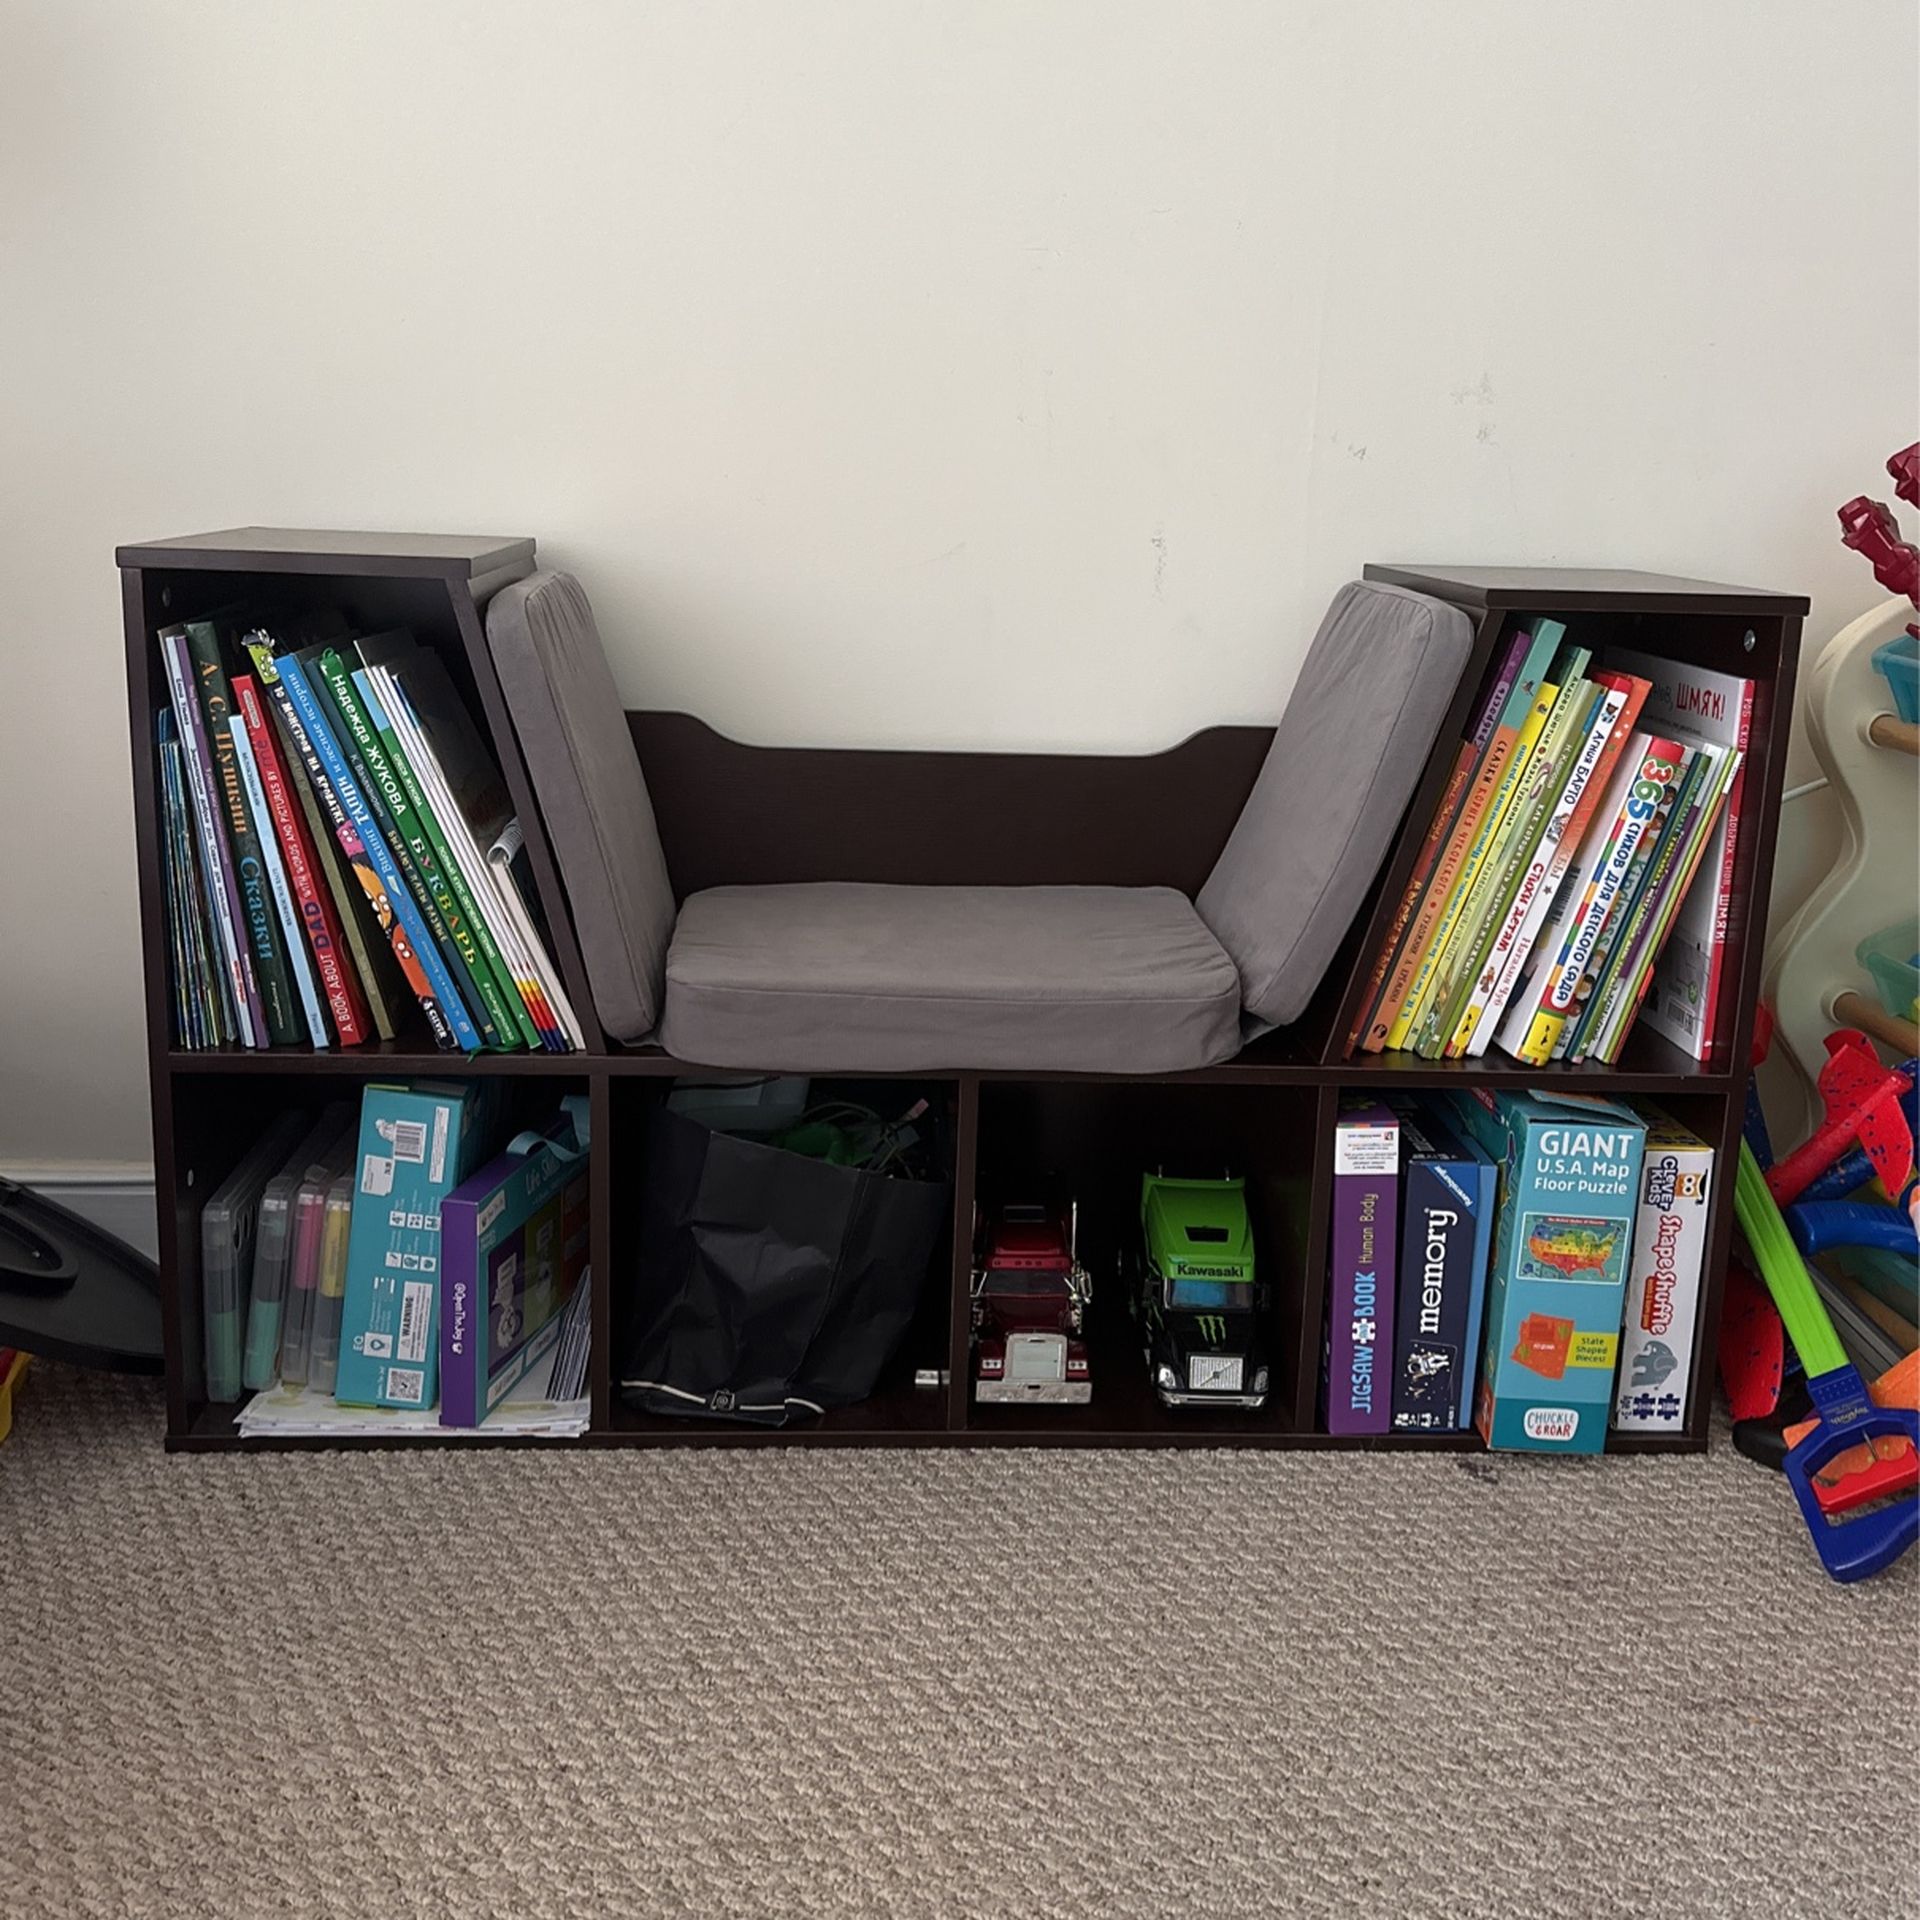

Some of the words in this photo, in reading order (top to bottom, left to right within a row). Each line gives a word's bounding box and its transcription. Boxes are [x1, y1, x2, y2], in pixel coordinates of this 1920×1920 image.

[201, 661, 216, 685] А.
[209, 696, 225, 721] С.
[288, 673, 315, 720] истории
[1673, 682, 1728, 718] ШМЯК!
[1742, 698, 1751, 716] РОБ
[313, 723, 336, 761] лесные
[332, 674, 369, 742] Надежда
[366, 745, 405, 814] ЖУКОВА
[1584, 730, 1604, 763] Агния
[281, 702, 310, 751] МОНСТРОВ
[307, 756, 319, 770] НА
[316, 775, 344, 822] КРОВАТКЕ
[1483, 740, 1506, 782] СКАЗКИ
[215, 733, 246, 831] Пушкин
[338, 776, 368, 824] ТАППИ
[1564, 765, 1589, 804] БАРТО
[1623, 759, 1676, 824] 365
[270, 782, 288, 822] PICTURES
[1463, 787, 1486, 826] КОРНЕЯ
[1532, 804, 1544, 821] КАК
[282, 824, 294, 840] AND
[364, 828, 391, 872] Викинг
[1613, 822, 1640, 867] СТИХОВ
[1726, 814, 1737, 854] ДОБРЫХ
[288, 843, 303, 873] WORDS
[1434, 832, 1467, 894] ЧУКОВСКОГО
[1504, 859, 1518, 881] БЫТЬ
[1720, 859, 1732, 888] СНОВ,
[297, 874, 311, 897] WITH
[388, 830, 412, 870] БЫВАЮТ
[410, 874, 427, 902] ПАПЫ
[426, 904, 447, 941] РАЗНЫЕ
[410, 837, 474, 962] БУКВАРЬ
[1599, 870, 1618, 900] ДЛЯ
[241, 854, 272, 957] Сказки
[1714, 894, 1729, 943] ШМЯК!
[302, 902, 329, 949] DAD
[1573, 902, 1604, 962] ДЕТСКОГО
[320, 954, 340, 988] ABOUT
[1557, 965, 1579, 1000] САДА
[332, 992, 349, 1021] BOOK
[1493, 986, 1509, 1005] Чуб
[1540, 1130, 1634, 1159] GIANT
[1534, 1177, 1576, 1192] Floor
[1578, 1180, 1628, 1194] Puzzle
[1537, 1158, 1586, 1176] U.S.A.
[1592, 1162, 1630, 1180] Map
[1360, 1194, 1378, 1222] Body
[1358, 1227, 1374, 1264] Human
[1652, 1215, 1682, 1271] Shape
[1177, 1263, 1244, 1279] Kawasaki
[1420, 1209, 1458, 1334] memory
[1354, 1271, 1376, 1316] BOOK
[1650, 1271, 1677, 1336] Shuffle
[402, 1296, 414, 1337] WARNING
[353, 1336, 364, 1351] EQ
[1576, 1346, 1608, 1354] Shaped
[1581, 1337, 1604, 1345] State
[1352, 1345, 1374, 1414] JIGSAW
[1528, 1412, 1574, 1428] CHUCKLE
[1543, 1424, 1571, 1437] ROAR
